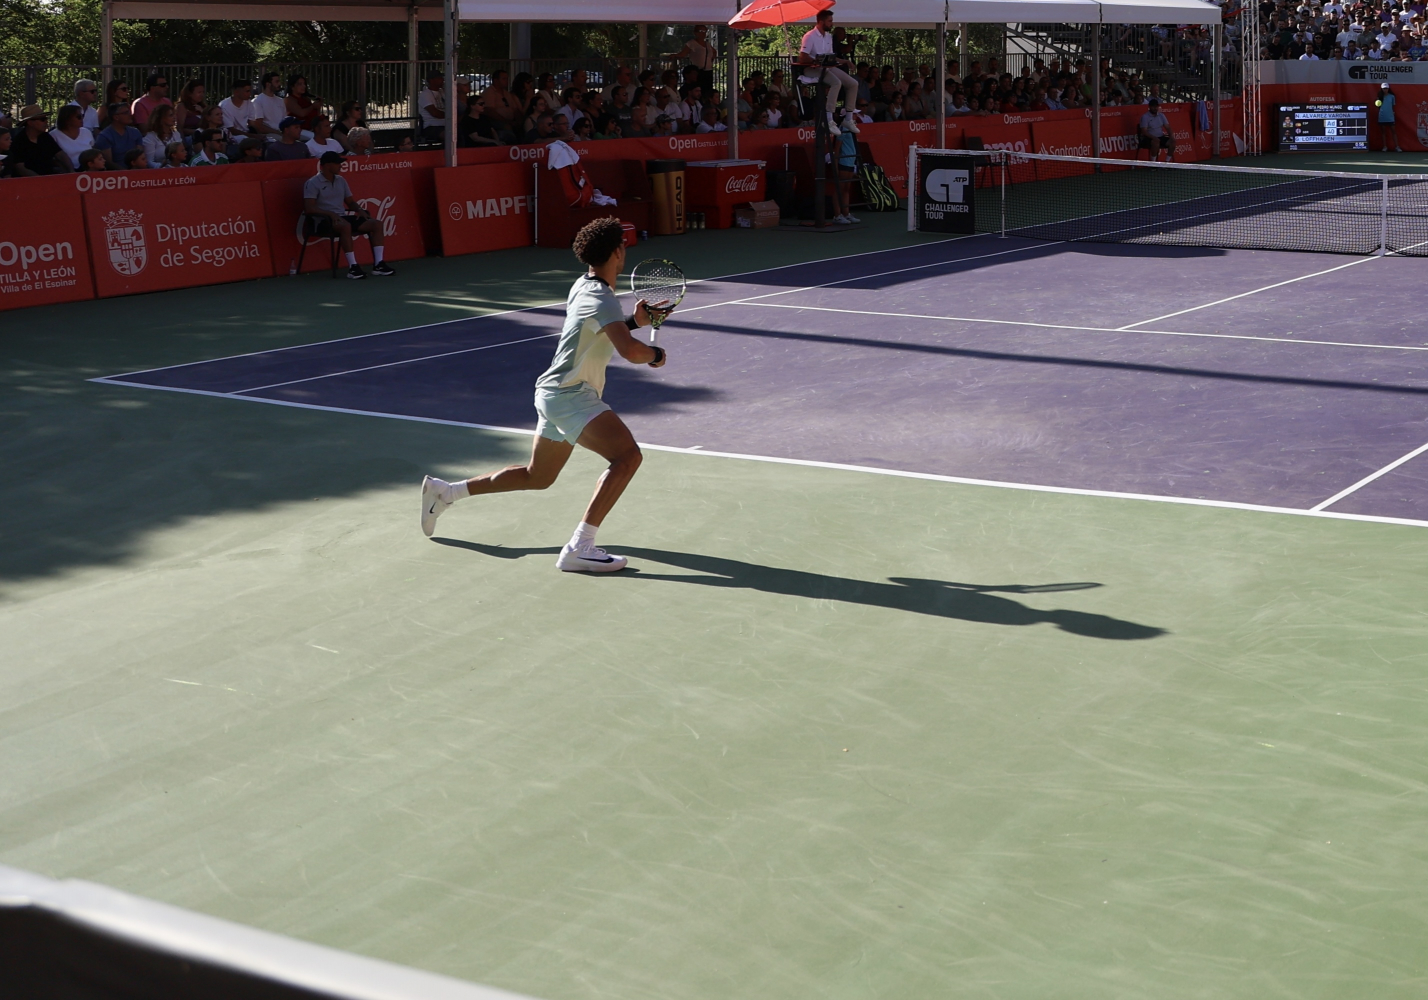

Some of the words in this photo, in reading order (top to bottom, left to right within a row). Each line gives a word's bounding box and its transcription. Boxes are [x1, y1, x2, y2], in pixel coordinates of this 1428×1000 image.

[1369, 65, 1413, 74] CHALLENGER
[1003, 114, 1021, 124] Open
[909, 121, 931, 133] Open
[798, 128, 816, 142] Ope
[669, 136, 697, 152] Open
[1049, 142, 1091, 158] Santander
[1100, 134, 1140, 154] AUTOFES
[509, 145, 545, 162] Open
[359, 163, 389, 171] CASTILLA
[395, 160, 412, 169] LEÓN
[76, 174, 129, 193] Open
[130, 178, 166, 188] CASTILLA
[174, 176, 196, 185] LEÓN
[675, 175, 683, 231] HEAD
[924, 203, 969, 213] CHALLENGER
[924, 212, 944, 220] TOUR
[155, 216, 256, 246] Diputación
[0, 241, 74, 270] Open
[159, 249, 185, 268] de
[190, 241, 260, 267] Segovia
[33, 270, 40, 280] Y
[44, 265, 76, 279] LEÓN
[1, 284, 20, 294] Villa
[22, 283, 33, 292] de
[35, 281, 43, 290] El
[46, 279, 77, 289] Espinar
